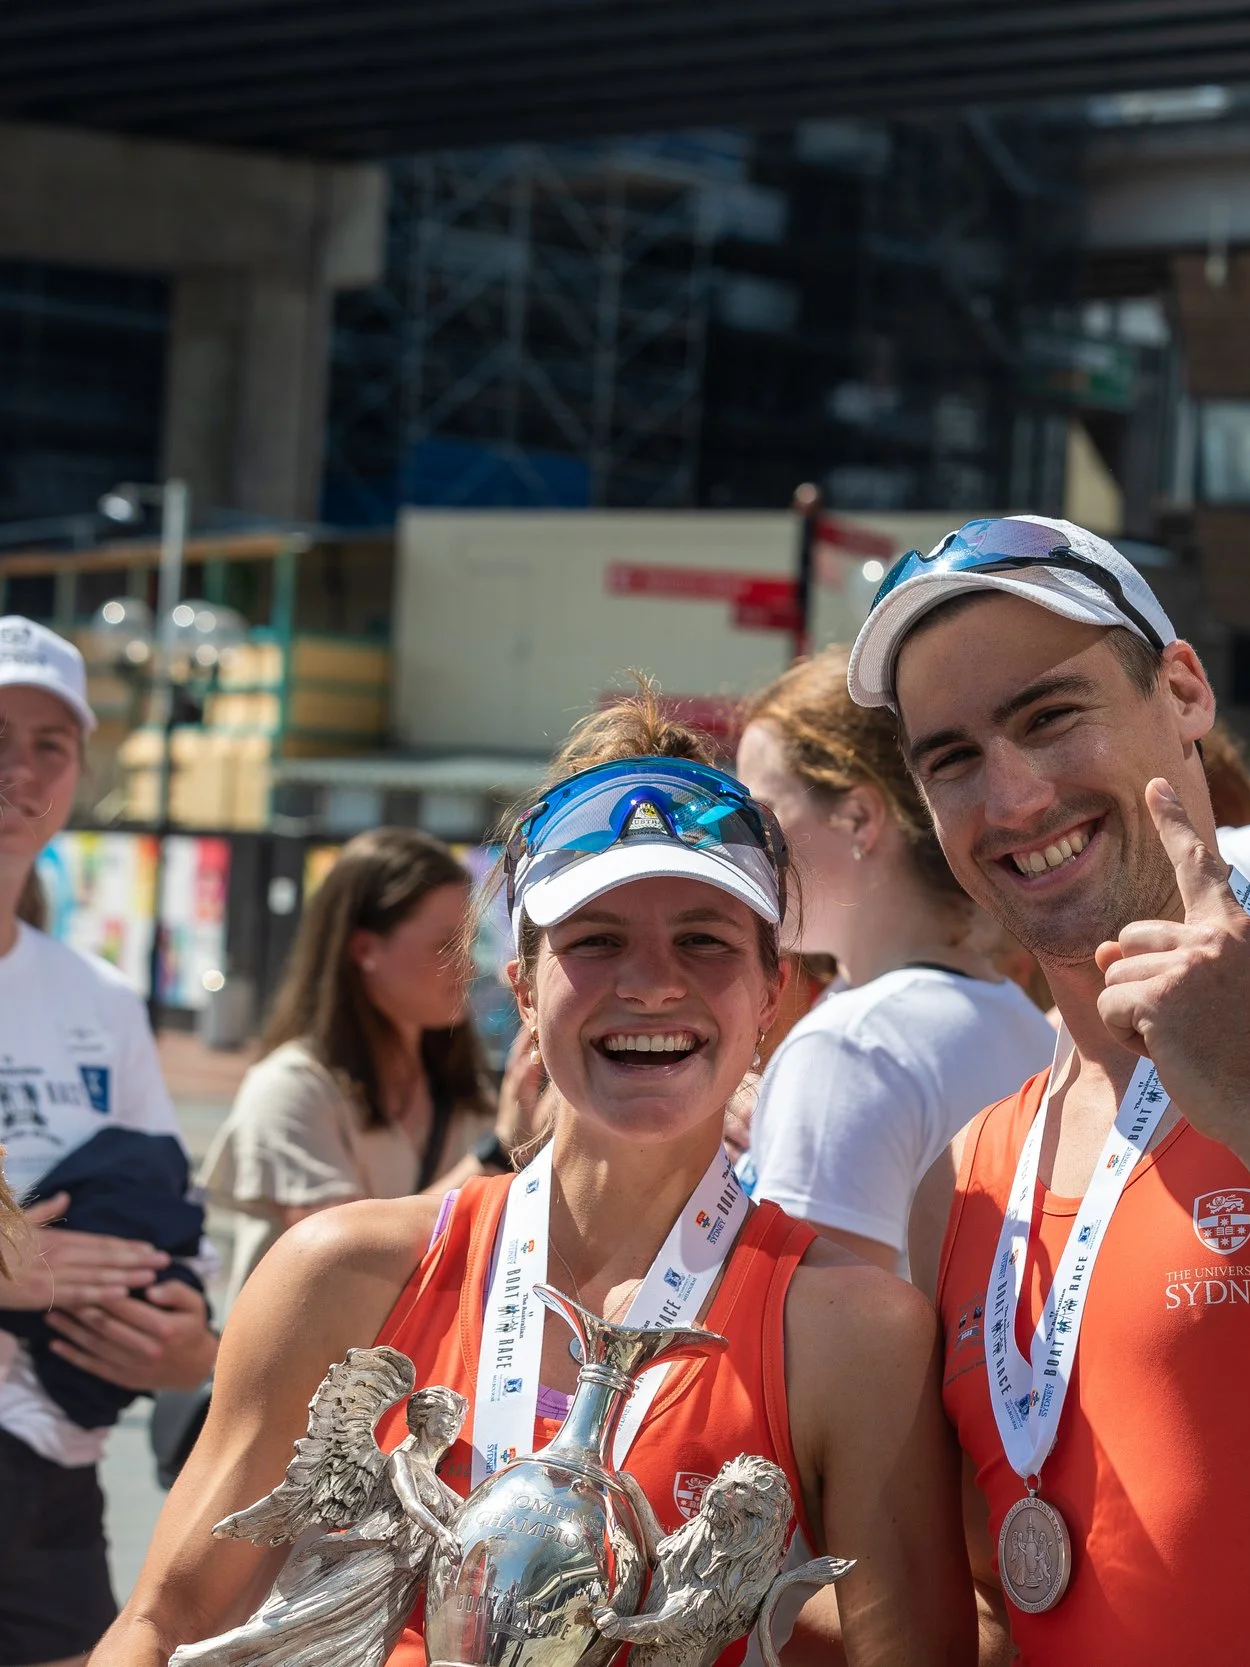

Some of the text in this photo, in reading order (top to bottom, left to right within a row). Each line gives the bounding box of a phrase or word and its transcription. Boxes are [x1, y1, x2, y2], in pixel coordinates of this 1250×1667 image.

[1128, 1109, 1152, 1141] BOAT
[717, 1183, 738, 1215] BOAT
[709, 1219, 726, 1245] SYDNEY
[505, 1268, 521, 1299] BOAT
[1069, 1256, 1088, 1291] RACE
[1166, 1269, 1191, 1283] THE
[994, 1281, 1008, 1316] BOAT
[1046, 1288, 1067, 1342] The Australian
[496, 1338, 514, 1369] RACE
[1044, 1341, 1064, 1377] BOAT
[997, 1356, 1012, 1396] RACE
[1040, 1384, 1055, 1417] SYDNEY
[486, 1444, 495, 1474] SYDNEY
[476, 1511, 583, 1550] CHAMPIO
